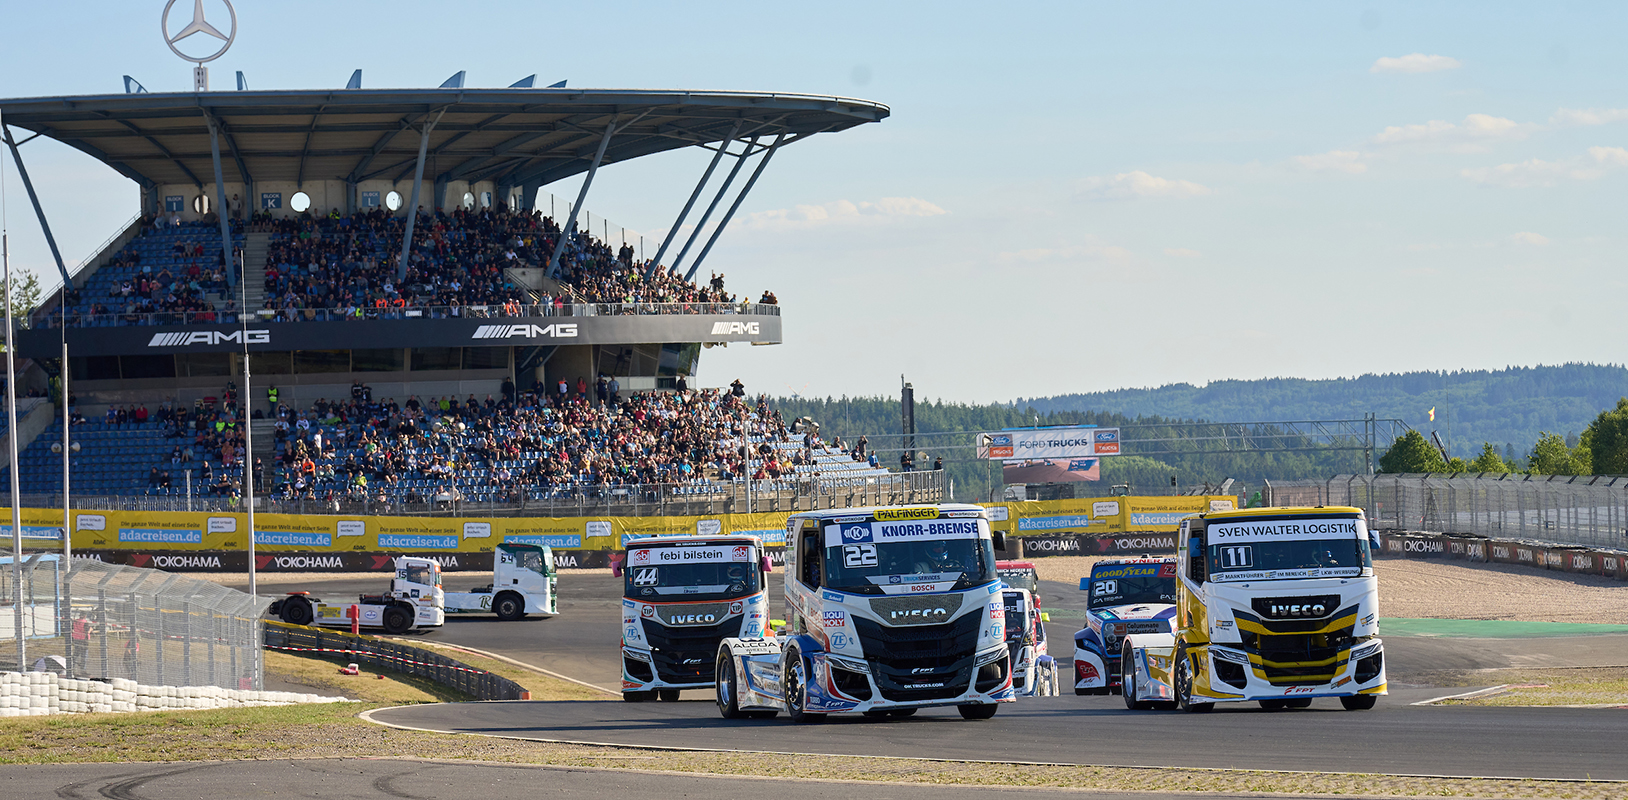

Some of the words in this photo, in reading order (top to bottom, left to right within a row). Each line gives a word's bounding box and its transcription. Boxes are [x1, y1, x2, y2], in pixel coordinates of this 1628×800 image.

[268, 199, 277, 208] K
[368, 198, 374, 207] L
[506, 323, 578, 338] AMG
[728, 321, 760, 335] AMG
[184, 330, 270, 346] AMG
[1020, 440, 1046, 449] FORD
[1047, 438, 1088, 448] TRUCKS
[878, 508, 936, 519] PALFINGER
[1020, 517, 1087, 529] adacreisen.de
[882, 522, 978, 537] KNORR-BREMSE
[1218, 527, 1250, 537] SVEN
[1250, 525, 1300, 535] WALTER
[1304, 523, 1356, 534] LOGISTIK
[120, 530, 200, 542] adacreisen.de
[380, 536, 456, 547] adacreisen.de
[1024, 540, 1080, 551] YOKOHAMA
[1114, 538, 1174, 549] YOKOHAMA
[660, 551, 680, 560] febi
[684, 550, 723, 559] bilstein
[846, 545, 877, 566] 22
[1228, 547, 1247, 566] 11
[152, 556, 221, 568] YOKOHAMA
[274, 557, 343, 568] YOKOHAMA
[634, 568, 657, 585] 44
[1095, 567, 1155, 578] GOODYEAR
[1095, 580, 1116, 596] 20
[891, 607, 946, 619] IVECO
[1272, 604, 1325, 616] IVECO
[671, 614, 715, 624] IVECO
[627, 629, 636, 637] ZF
[750, 624, 758, 632] ZF
[834, 636, 844, 644] ZF
